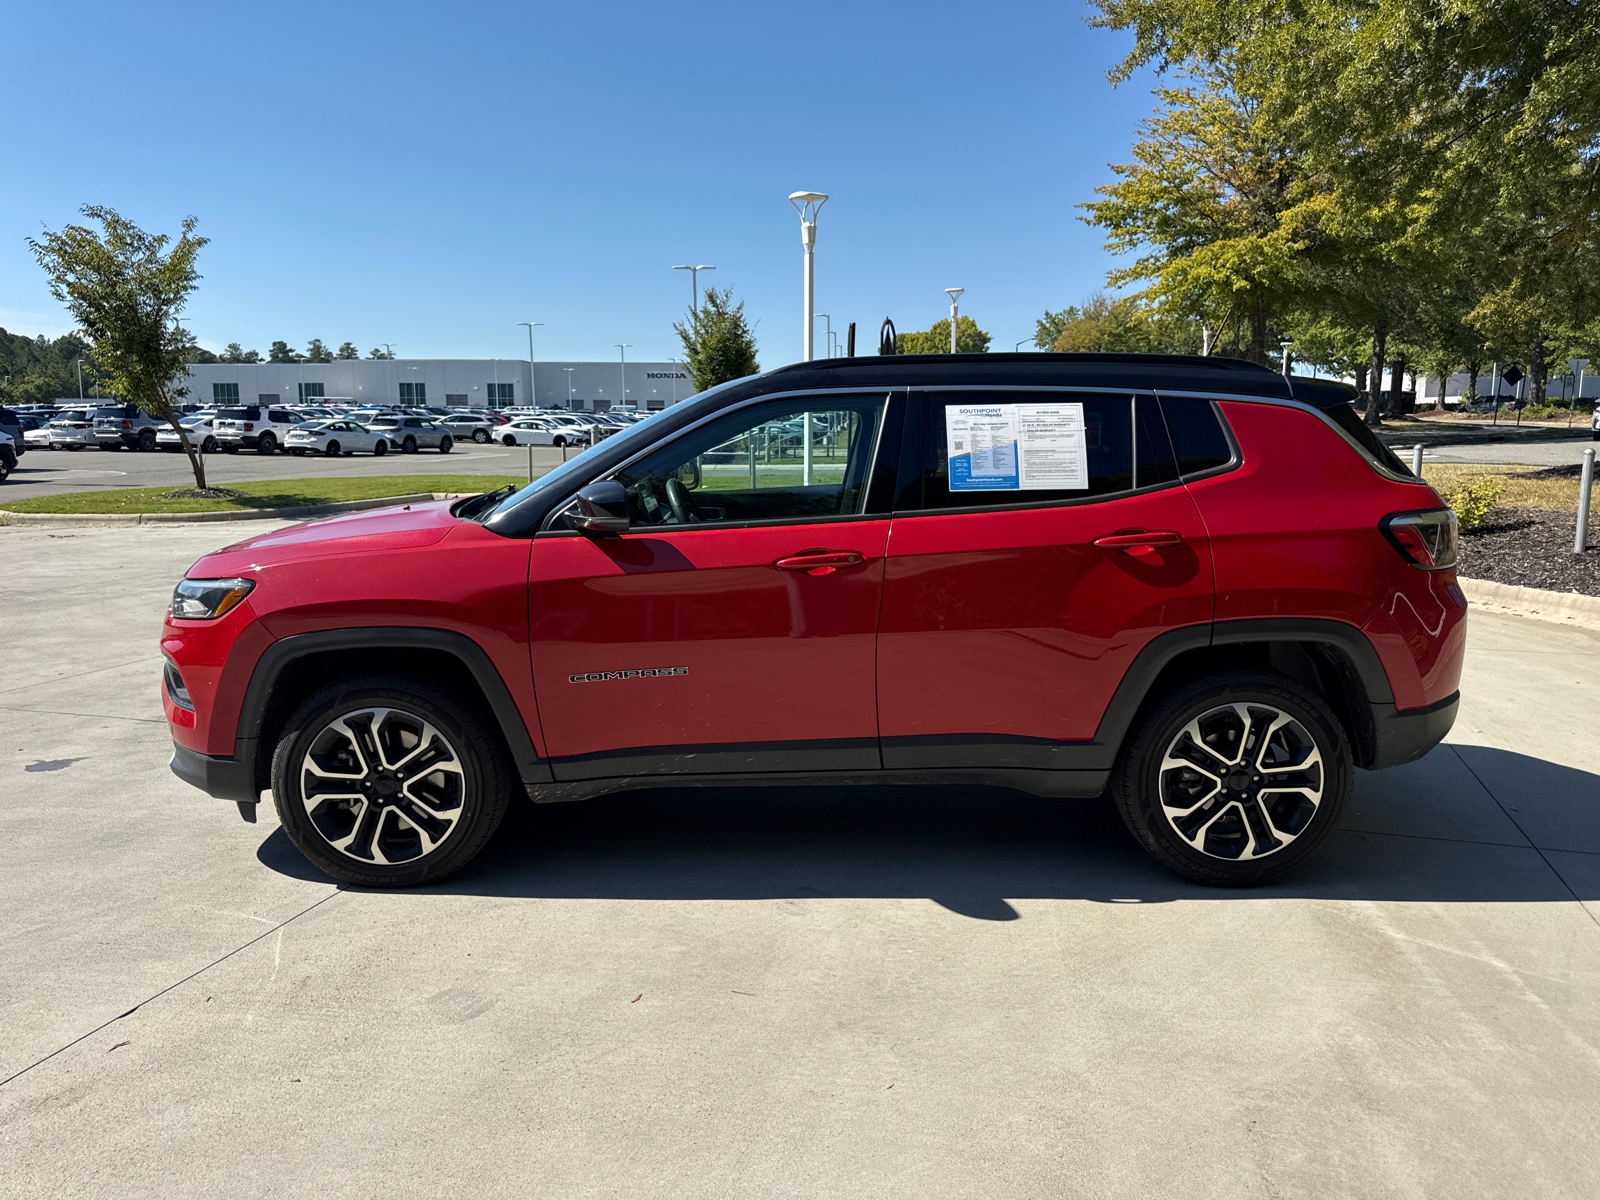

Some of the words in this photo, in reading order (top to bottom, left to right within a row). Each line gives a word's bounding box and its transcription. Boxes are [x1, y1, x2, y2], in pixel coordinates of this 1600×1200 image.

[569, 666, 689, 684] COMPASS
[378, 690, 434, 711] GR906
[1270, 688, 1320, 718] GR906
[318, 855, 397, 883] IRONMAN
[1157, 837, 1229, 880] IRONMAN
